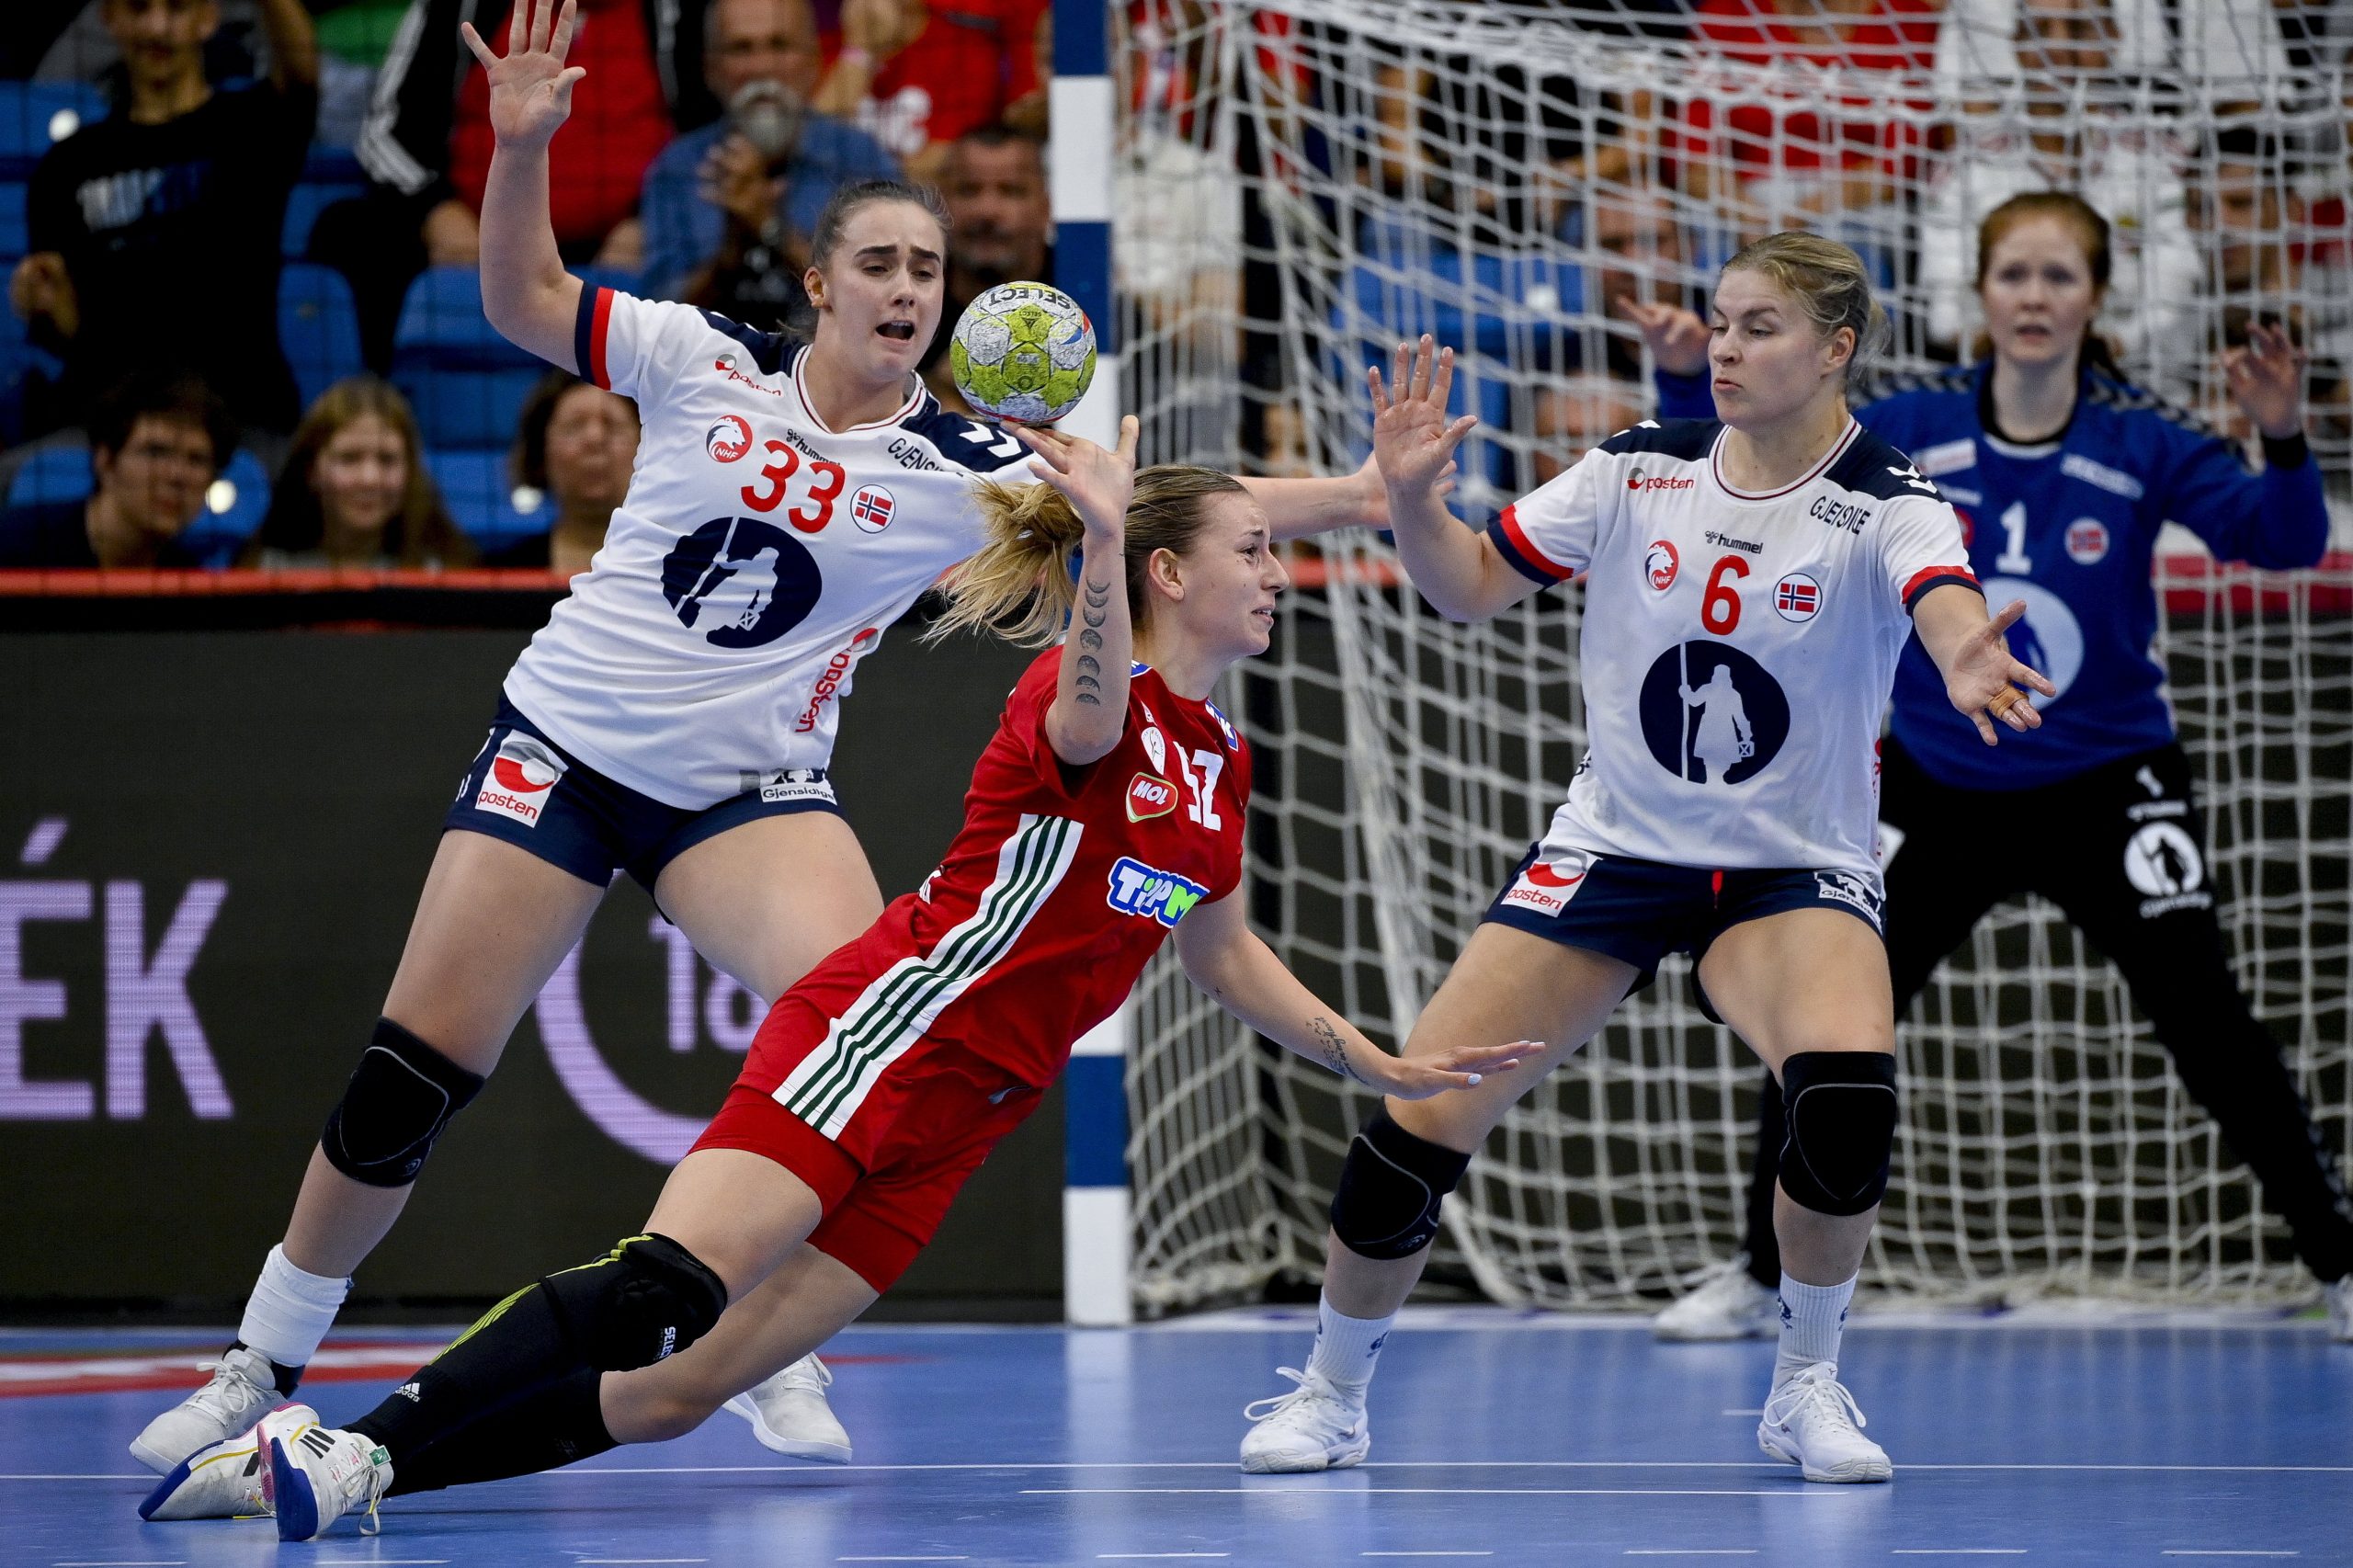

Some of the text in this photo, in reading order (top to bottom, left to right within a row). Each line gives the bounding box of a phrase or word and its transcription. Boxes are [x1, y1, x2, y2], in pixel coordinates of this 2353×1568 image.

[989, 287, 1071, 309] SELECT
[716, 448, 738, 459] NHF
[741, 439, 846, 534] 33
[1646, 477, 1694, 493] posten
[1718, 534, 1763, 554] hummel
[1995, 500, 2032, 575] 1
[1654, 575, 1672, 585] NHF
[1700, 554, 1750, 635] 6
[1132, 780, 1168, 805] MOL
[477, 791, 538, 819] posten
[1505, 889, 1563, 909] posten
